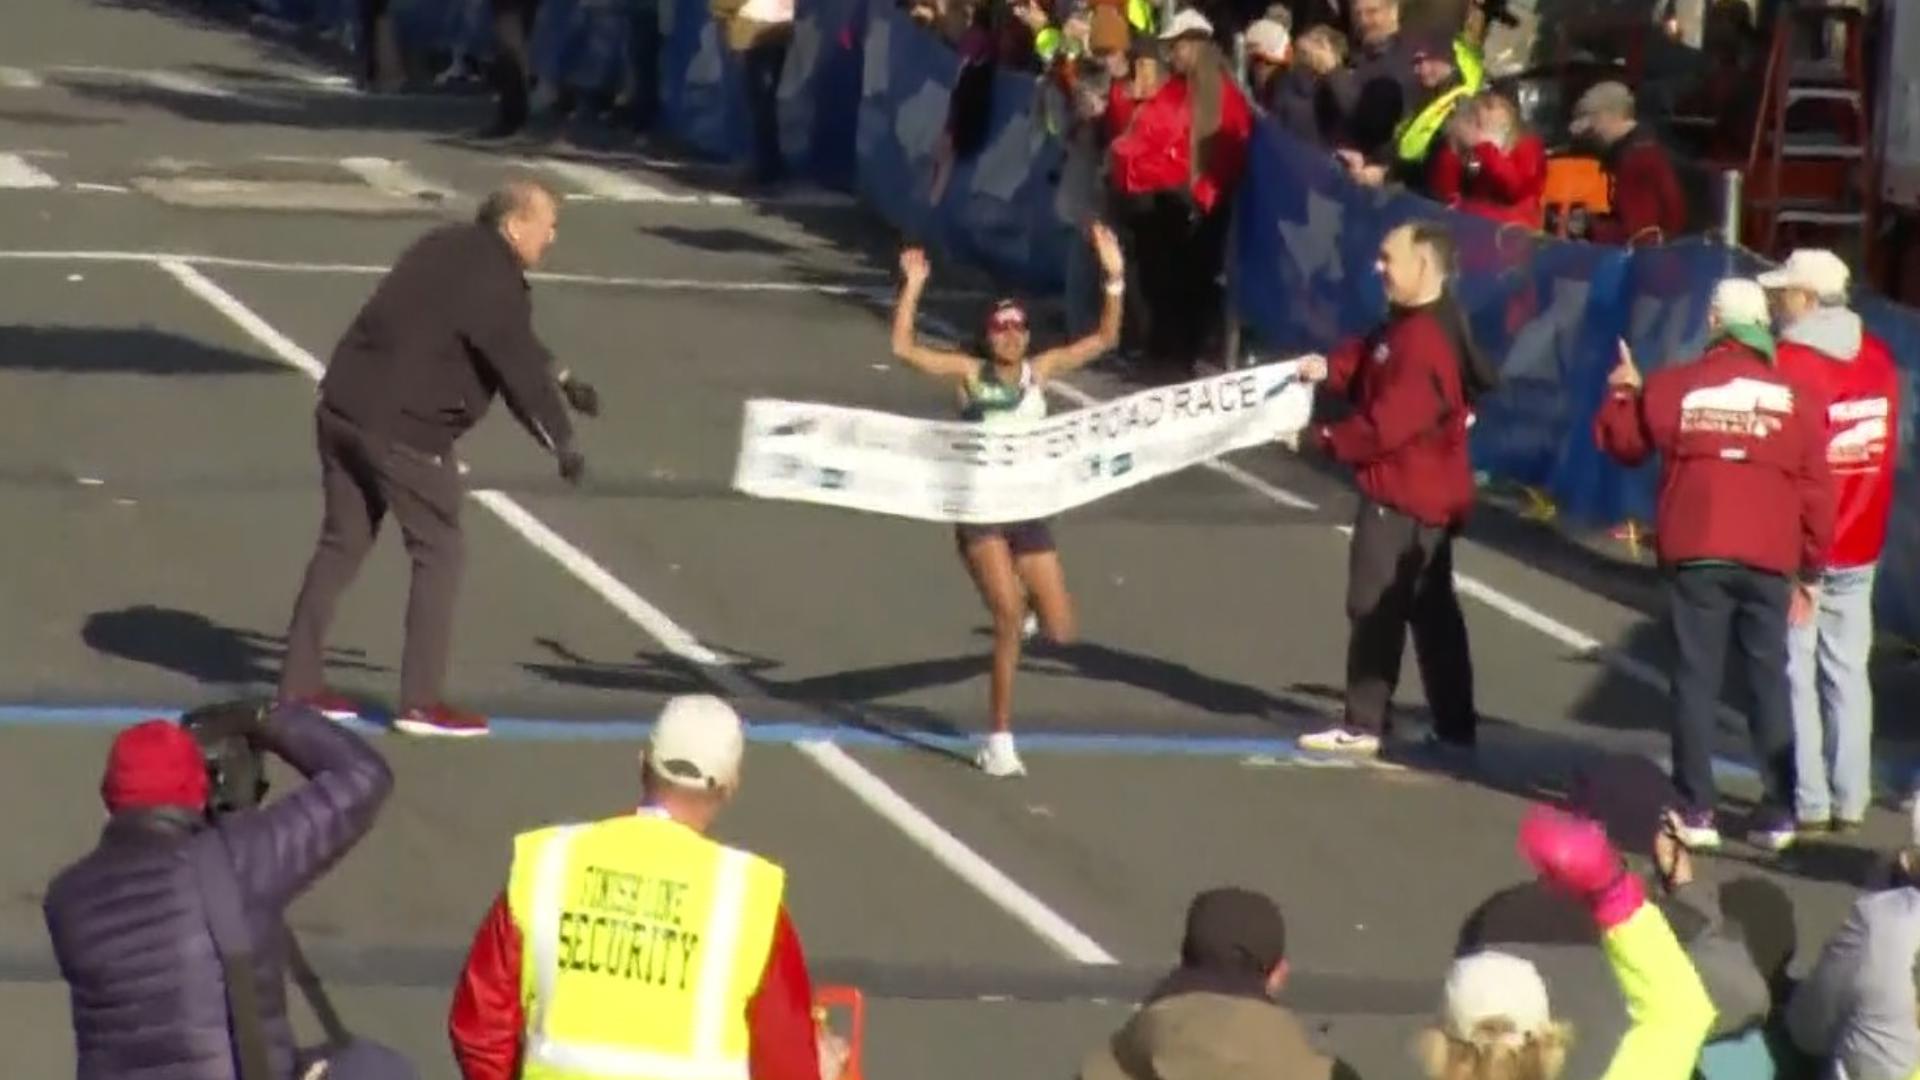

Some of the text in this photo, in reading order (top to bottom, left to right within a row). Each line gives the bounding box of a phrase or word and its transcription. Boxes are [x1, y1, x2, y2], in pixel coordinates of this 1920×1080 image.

[1089, 396, 1164, 439] ROAD
[1173, 375, 1257, 417] RACE
[557, 911, 699, 990] SECURITY
